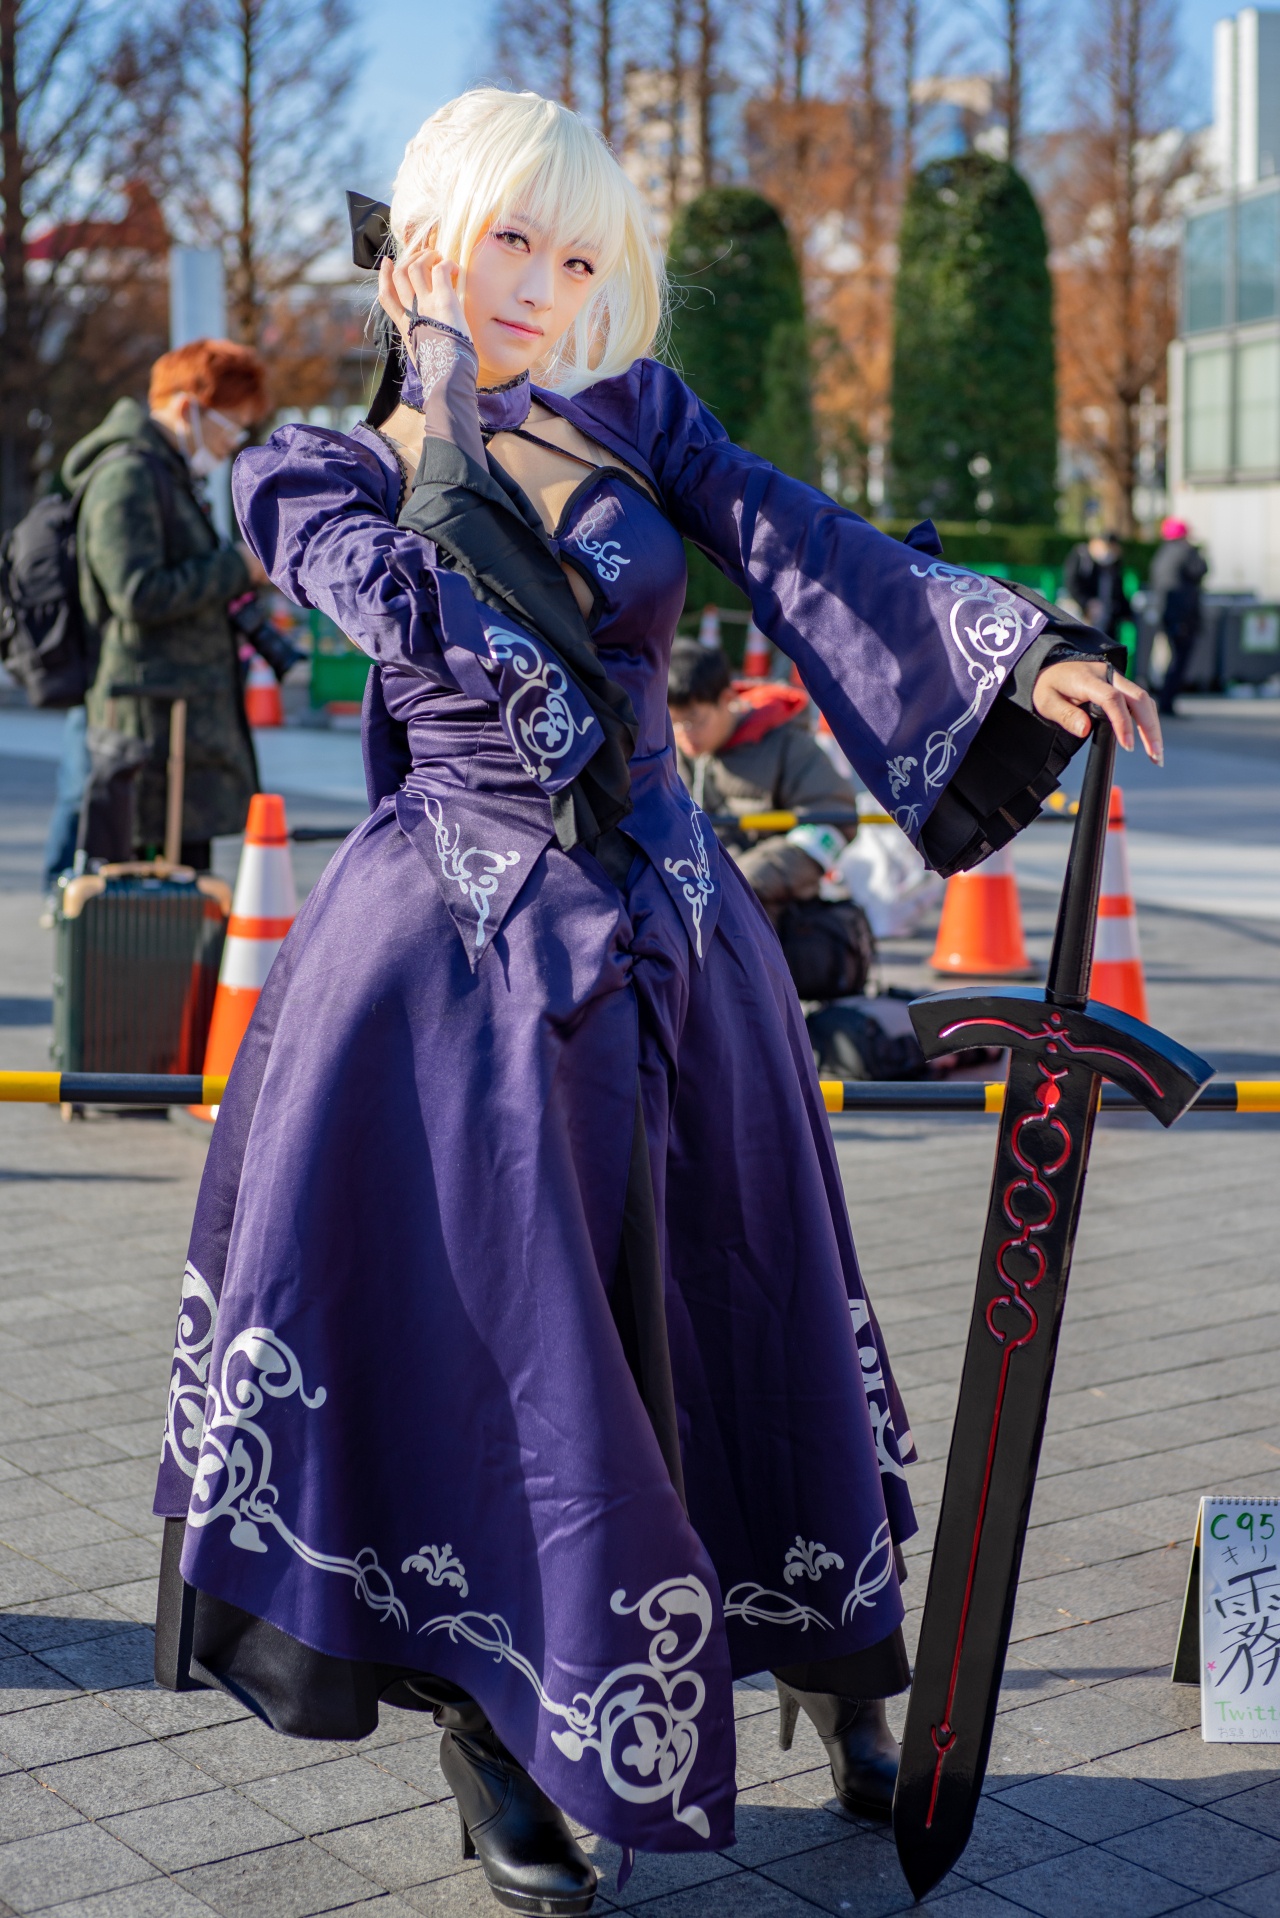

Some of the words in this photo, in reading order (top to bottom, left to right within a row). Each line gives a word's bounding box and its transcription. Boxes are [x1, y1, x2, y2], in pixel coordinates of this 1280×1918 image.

[1210, 1512, 1275, 1542] C95
[1221, 1544, 1268, 1565] キリ
[1213, 1701, 1280, 1722] Twitt
